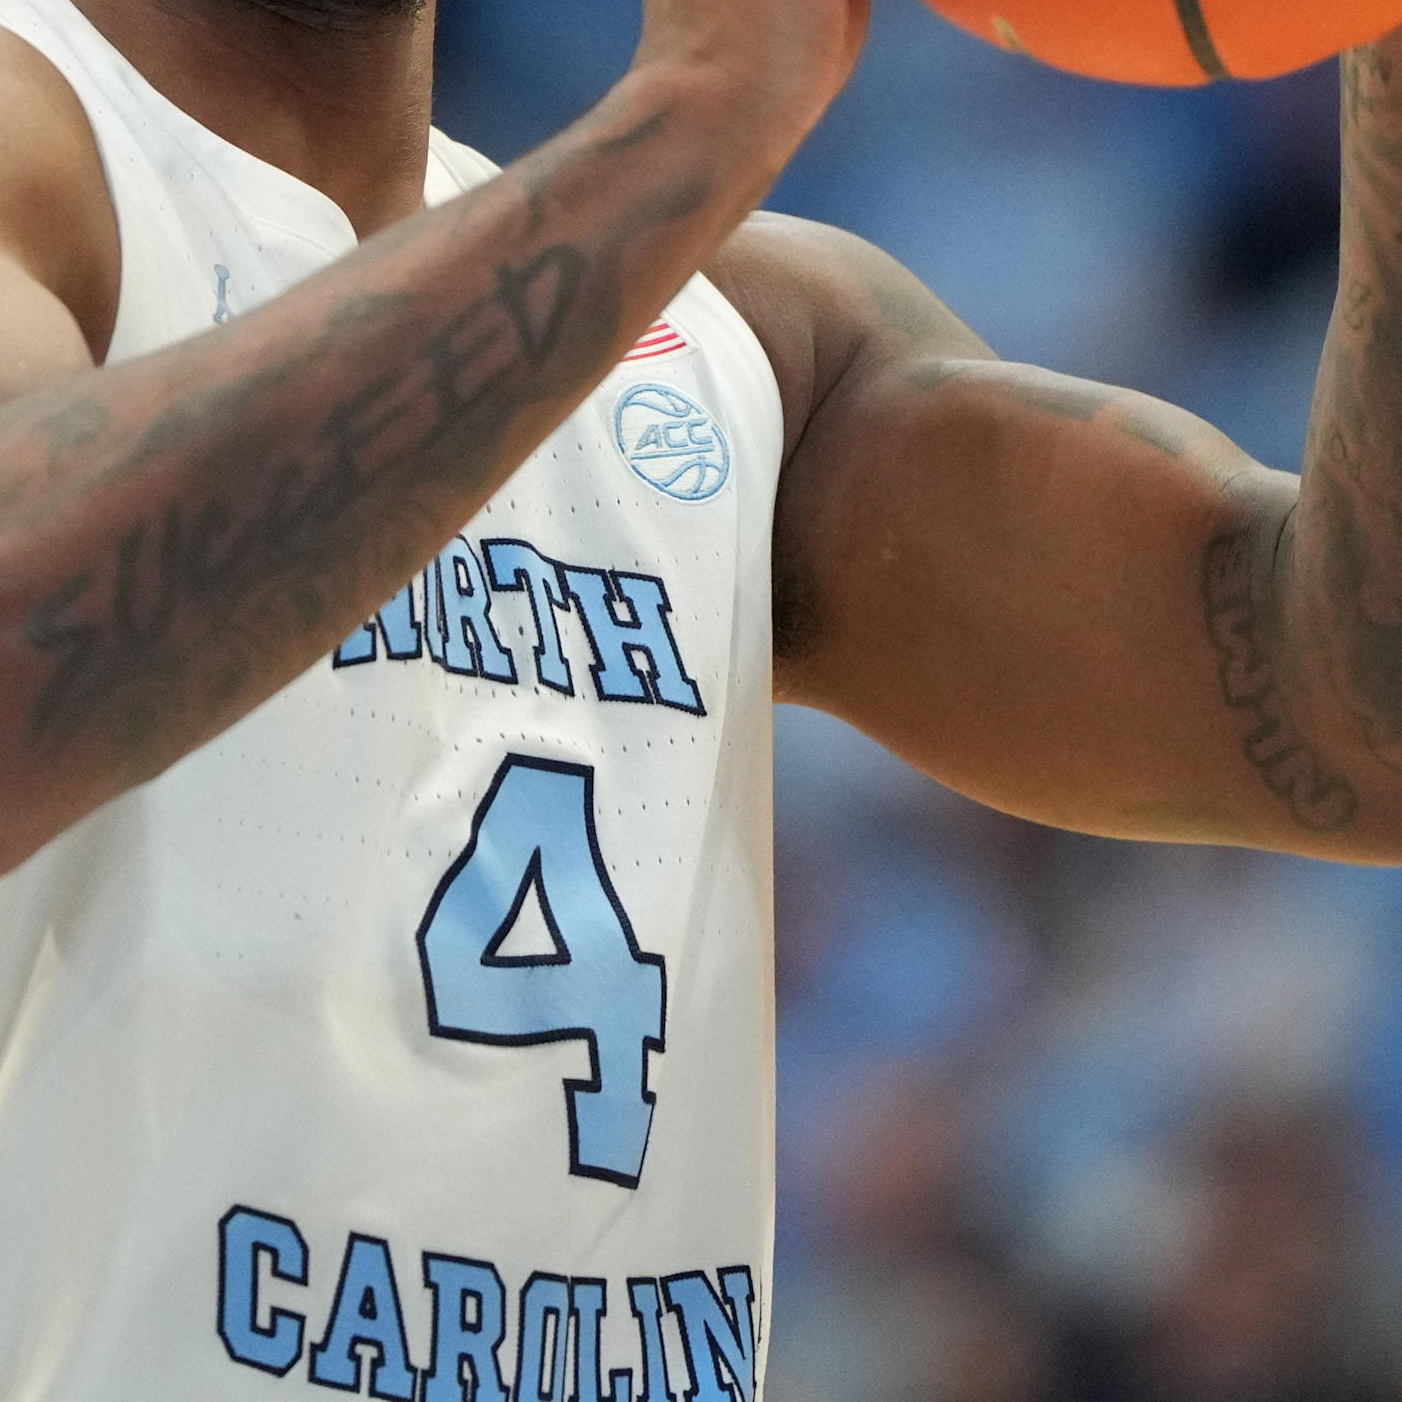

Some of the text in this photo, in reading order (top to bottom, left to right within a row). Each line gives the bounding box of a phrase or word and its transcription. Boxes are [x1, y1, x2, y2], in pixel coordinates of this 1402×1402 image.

[635, 418, 714, 451] ACC
[333, 535, 707, 717] RTH
[416, 751, 668, 1191] 4
[217, 1204, 757, 1402] CAROLIN
